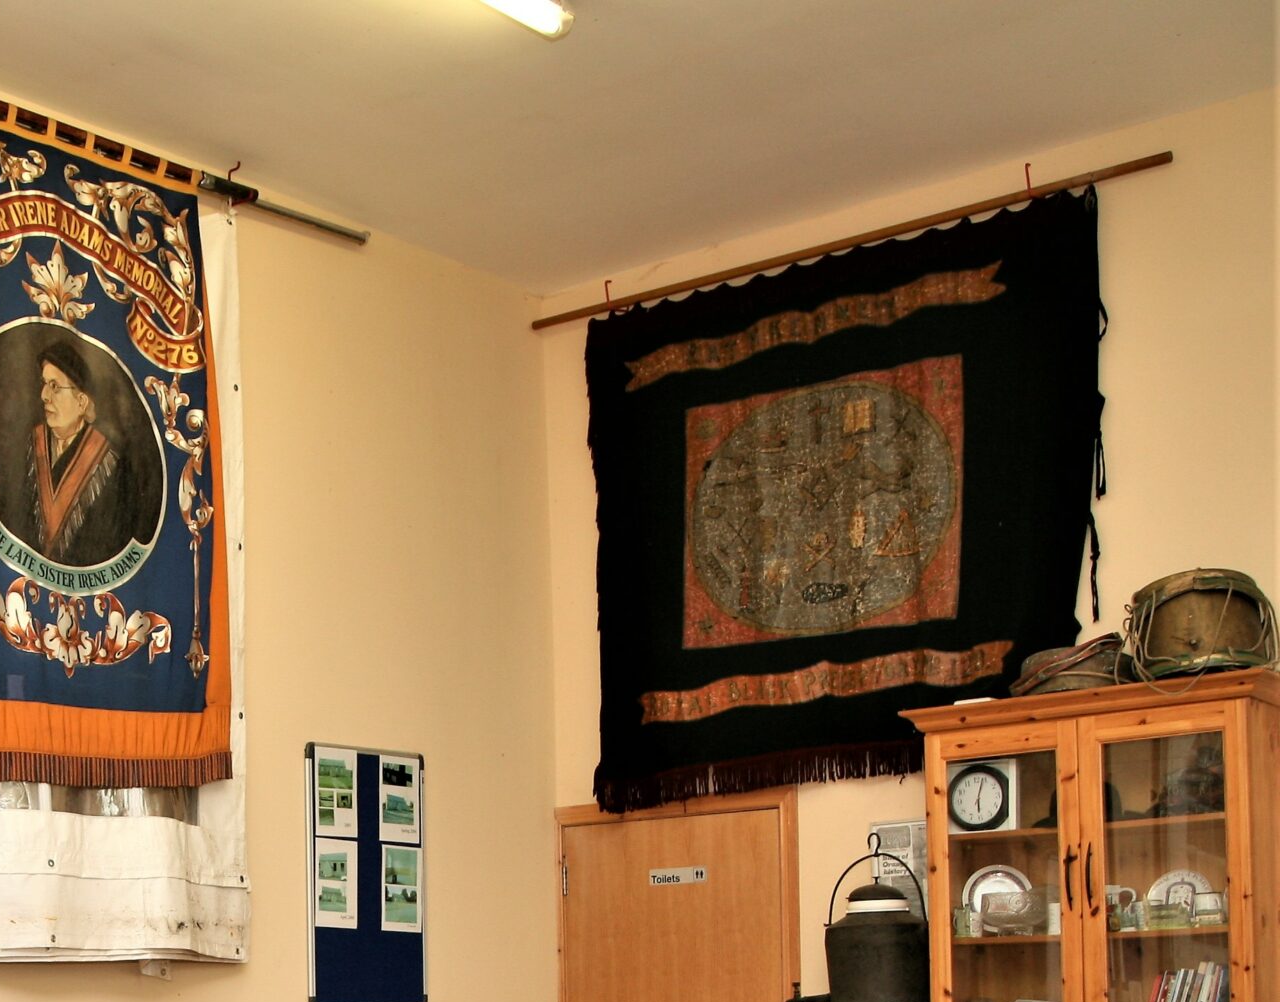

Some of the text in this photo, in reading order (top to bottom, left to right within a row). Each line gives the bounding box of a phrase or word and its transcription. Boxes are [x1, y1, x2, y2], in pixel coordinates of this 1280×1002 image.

[8, 200, 58, 228] IRENE
[60, 210, 113, 262] ADAMS
[113, 248, 184, 325] MEMORIAL
[152, 339, 199, 365] 276
[4, 543, 37, 573] LATE
[36, 562, 76, 591] SISTER
[78, 568, 111, 590] IRENE
[651, 874, 681, 884] Toilets
